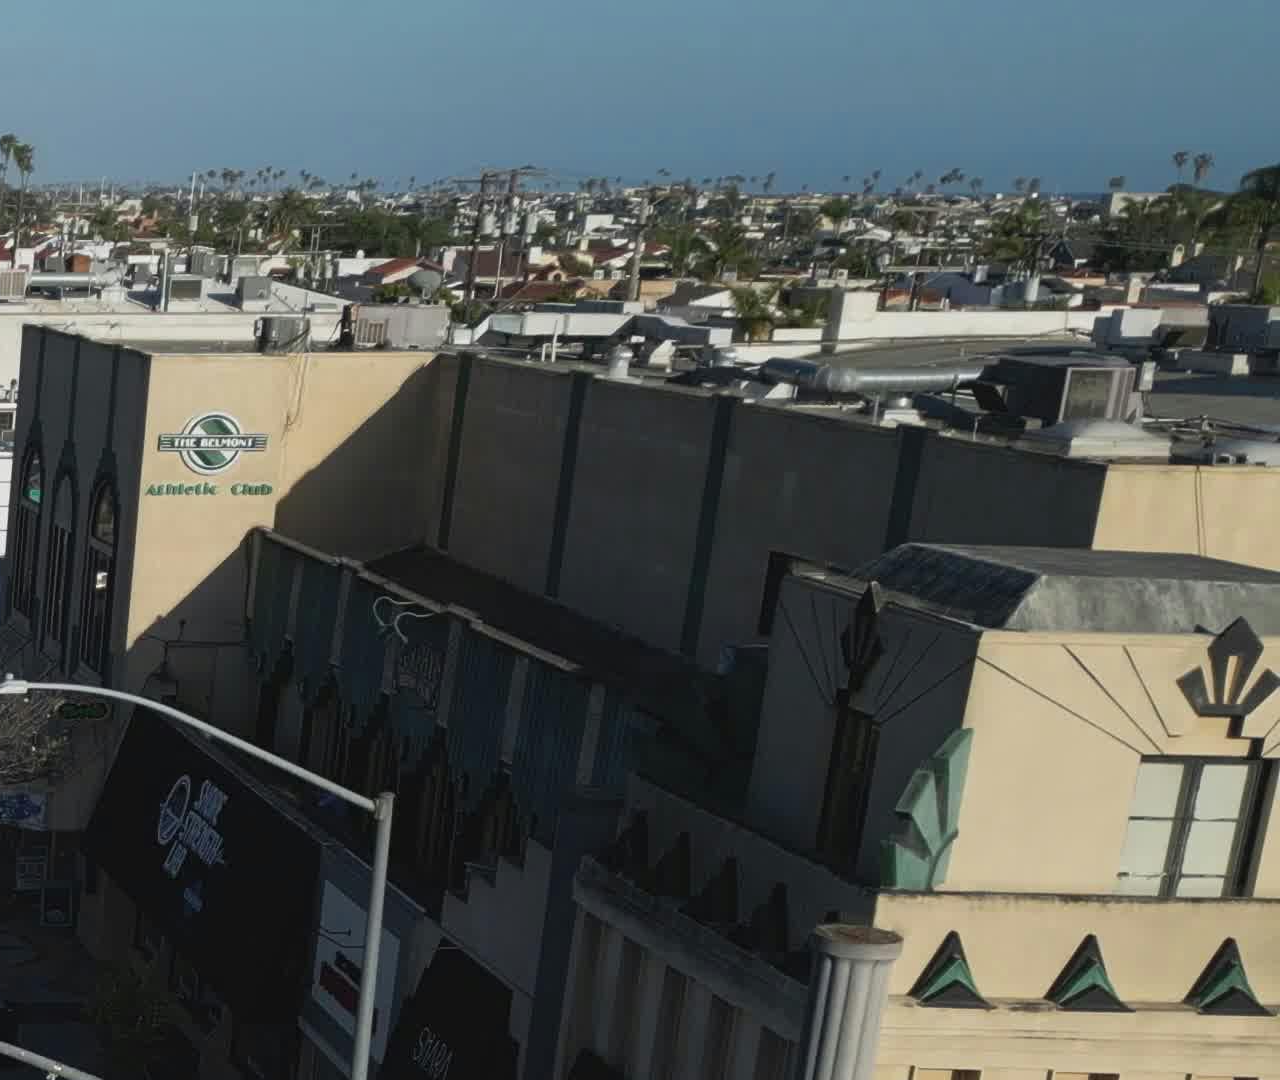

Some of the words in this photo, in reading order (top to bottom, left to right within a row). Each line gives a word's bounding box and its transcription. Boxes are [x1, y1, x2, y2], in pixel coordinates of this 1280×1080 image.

[174, 438, 197, 448] THE
[200, 438, 253, 448] BELMONT
[145, 482, 217, 496] Athletic
[230, 483, 273, 496] Club
